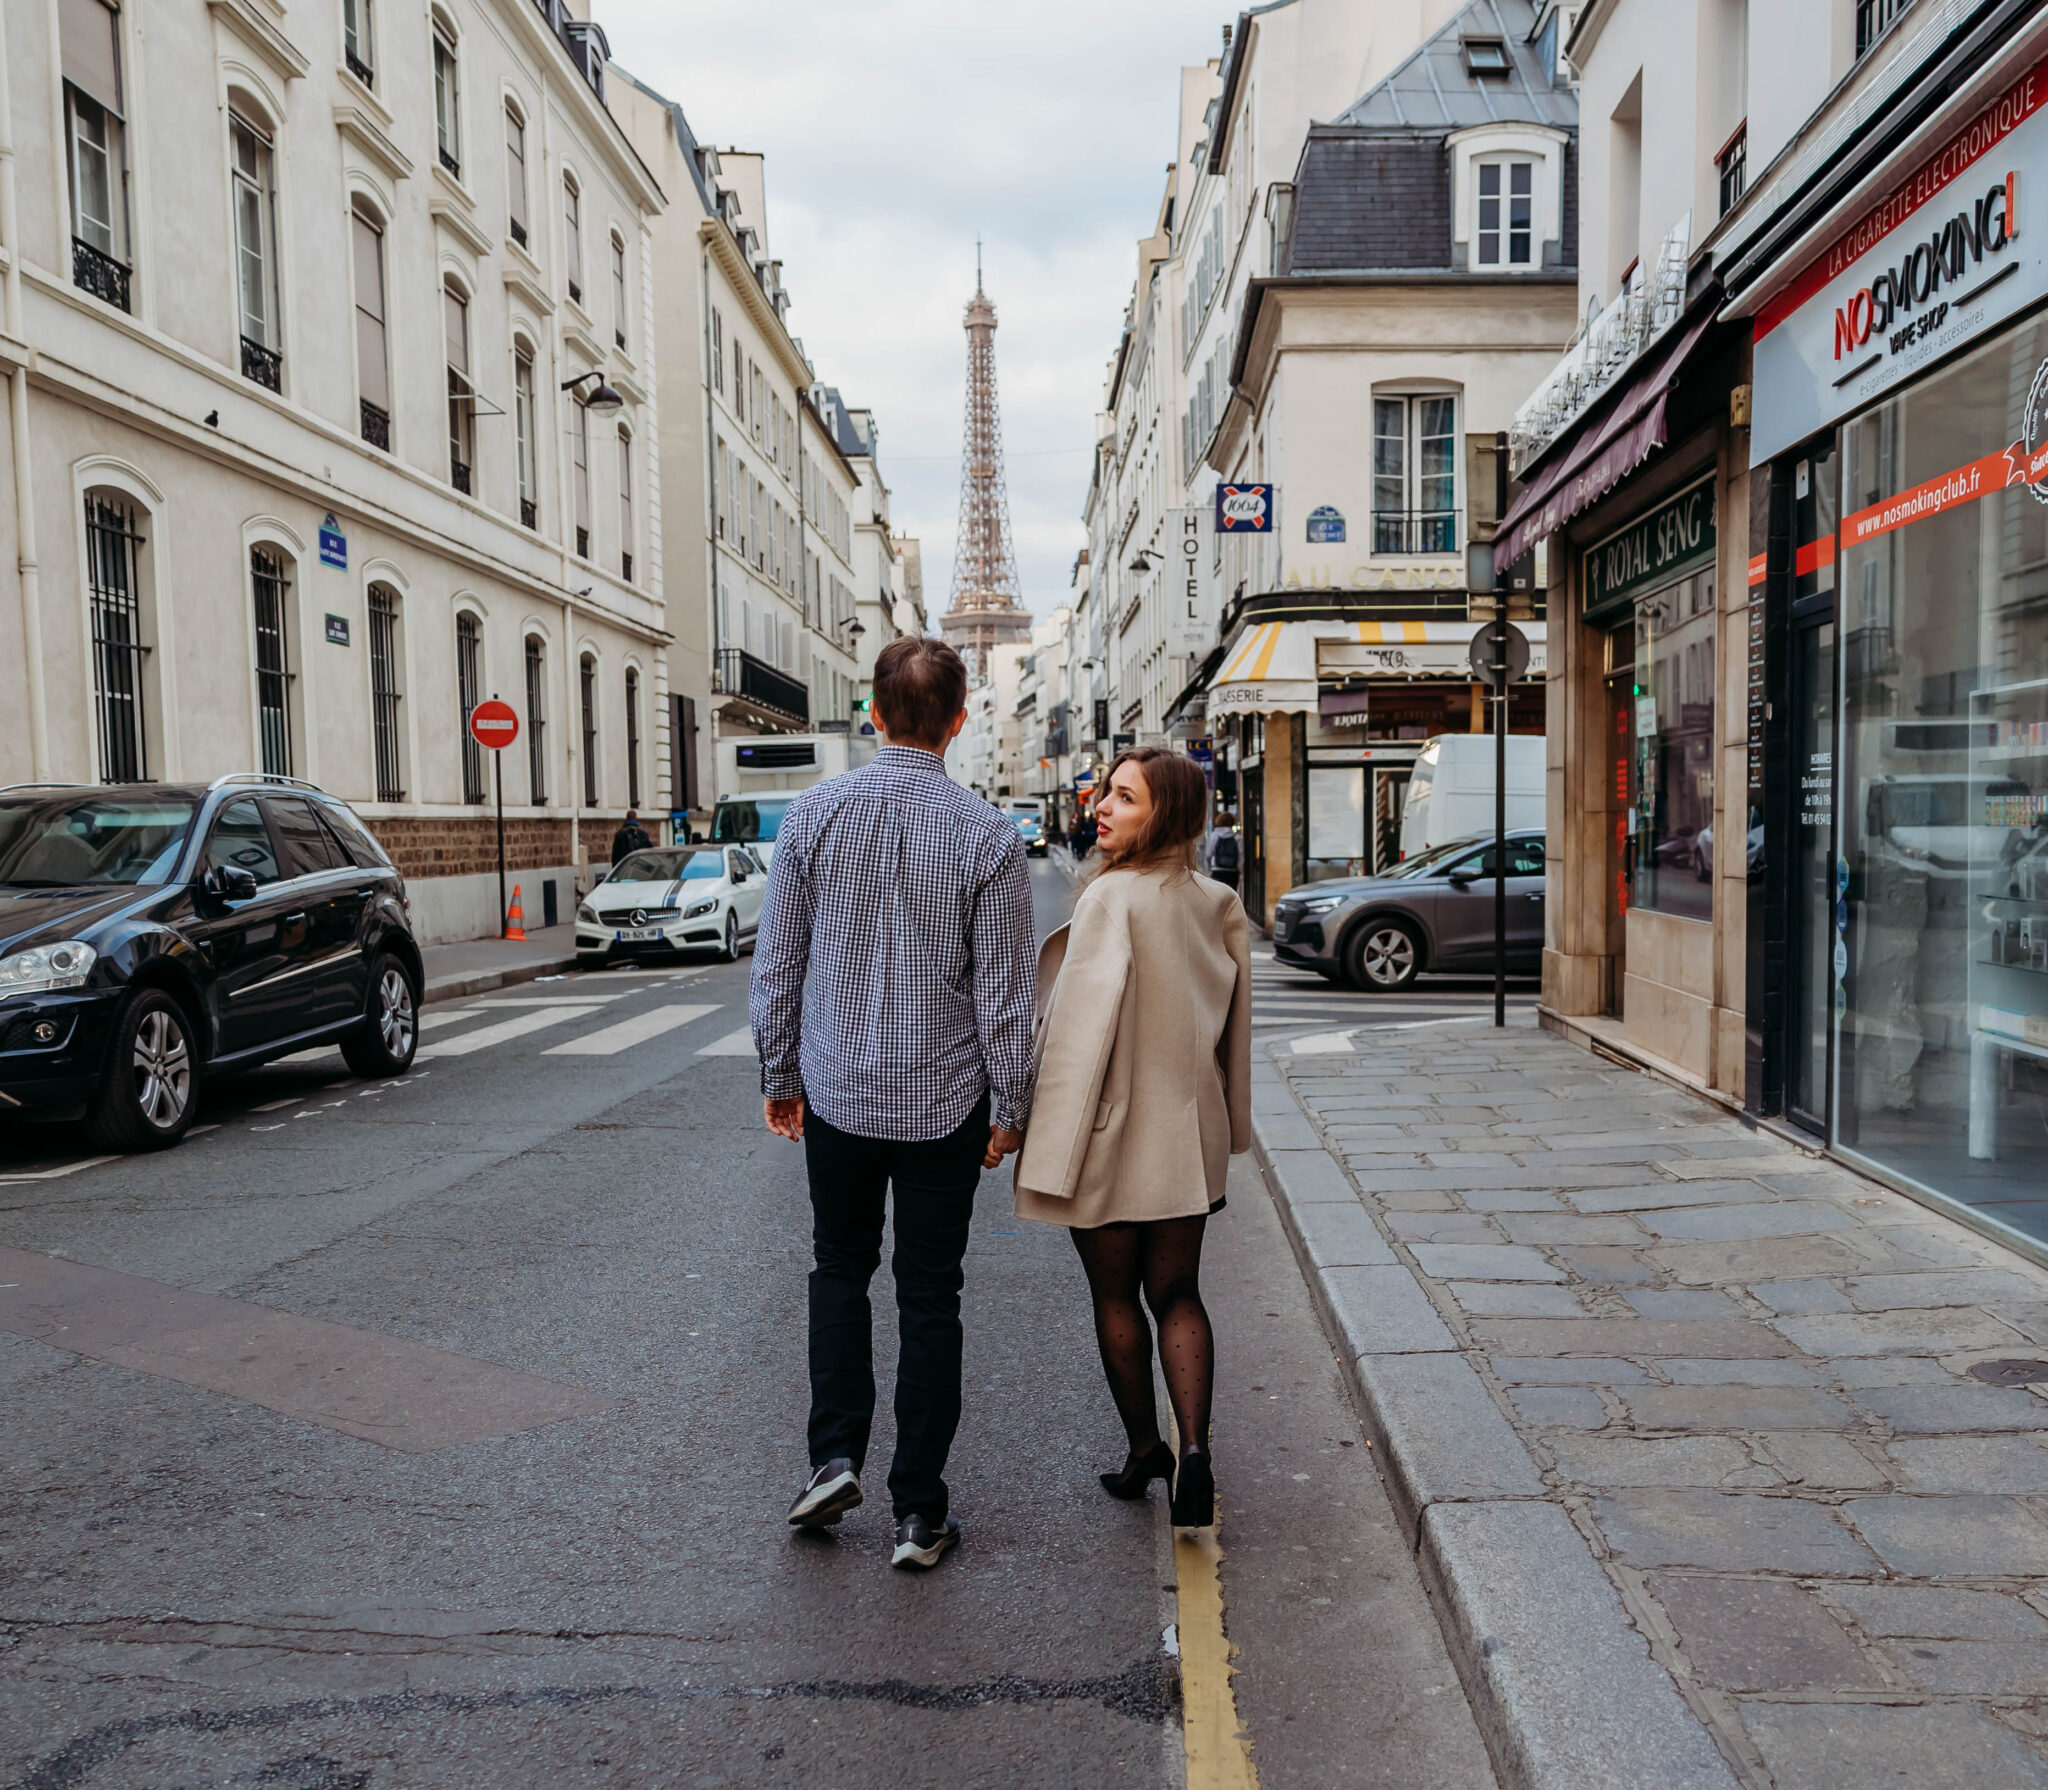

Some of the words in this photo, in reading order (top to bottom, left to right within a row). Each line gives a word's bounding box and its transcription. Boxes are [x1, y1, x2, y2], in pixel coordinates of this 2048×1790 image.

[1829, 253, 1842, 278] LA
[1847, 189, 1913, 262] CIGARETTE
[1917, 76, 2036, 205] ELECTRONIQUE
[1890, 322, 1916, 356] VAPE
[1917, 301, 1948, 338] SHOP
[1938, 306, 1985, 348] accessoires
[1227, 499, 1260, 513] 1664
[1857, 467, 1981, 537] www.nosmokingclub.fr
[1184, 516, 1198, 618] HOTEL
[1606, 525, 1650, 591] ROYAL
[1656, 492, 1701, 566] SENG
[1285, 565, 1330, 590] AU
[1350, 564, 1457, 588] CANO
